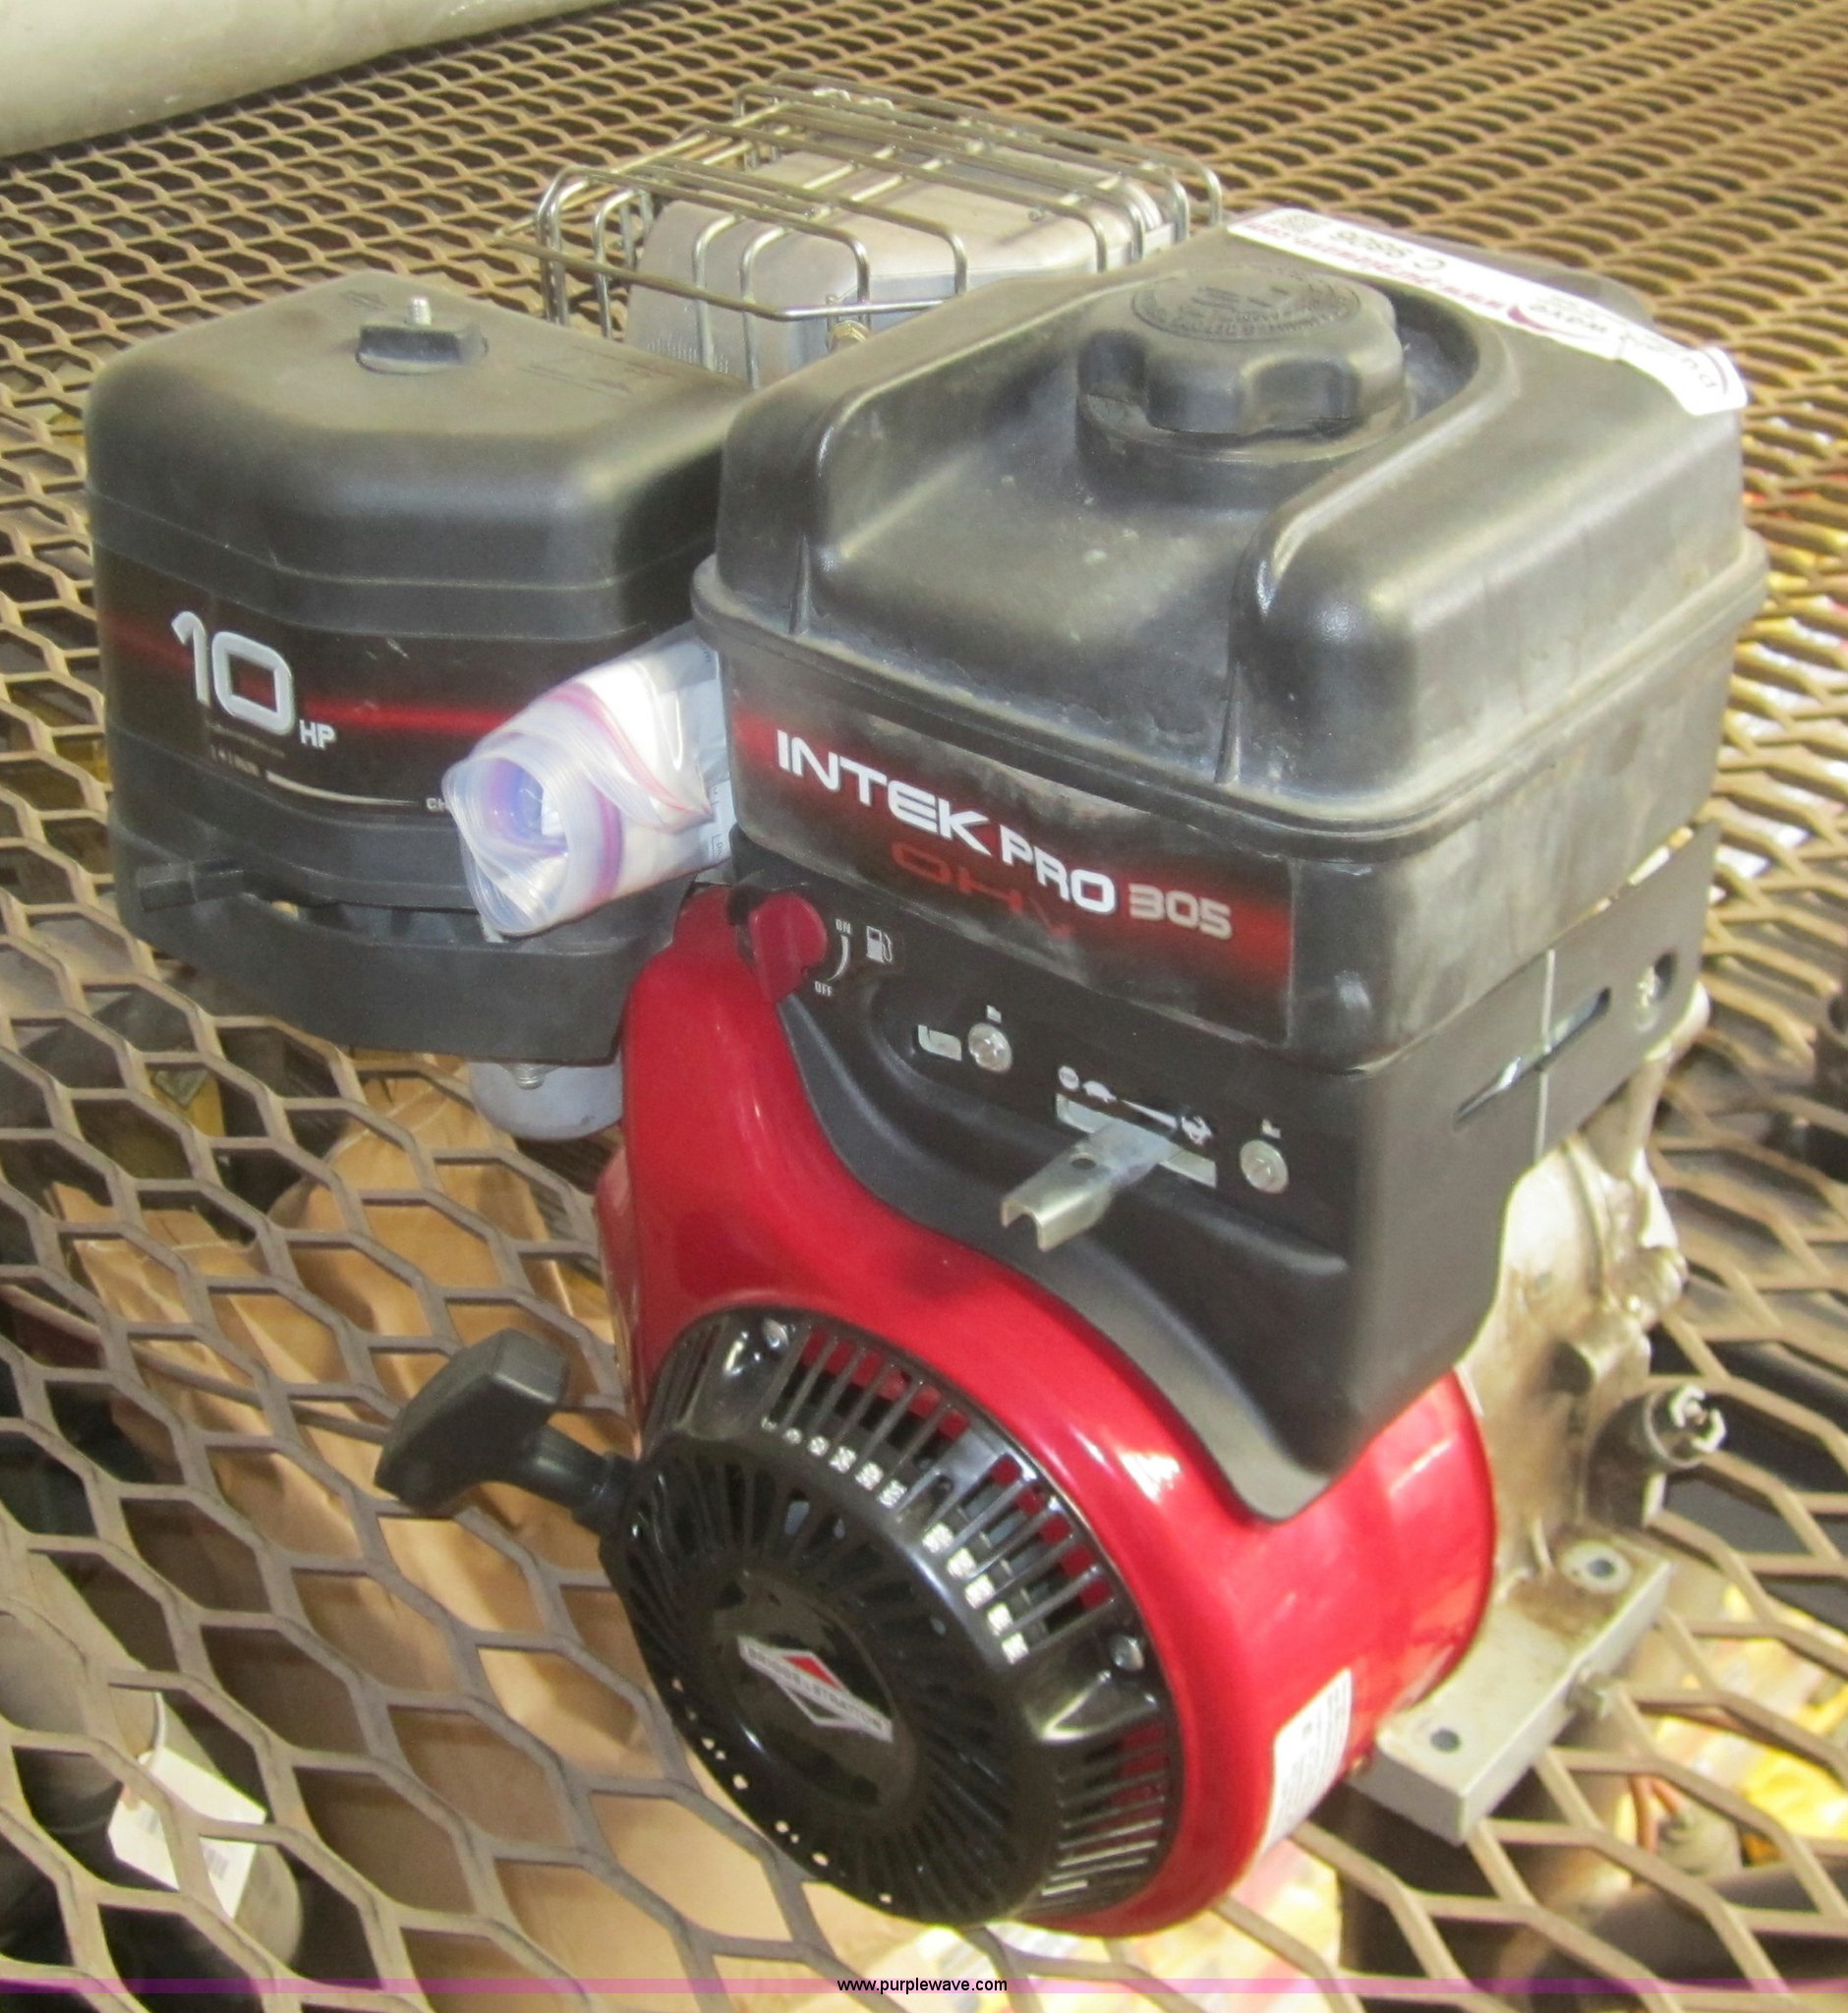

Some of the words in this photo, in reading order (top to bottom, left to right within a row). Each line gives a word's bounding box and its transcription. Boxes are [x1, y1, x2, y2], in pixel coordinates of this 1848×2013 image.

[171, 610, 294, 735] 10
[299, 719, 335, 750] HP
[777, 730, 991, 855] INTEK
[999, 824, 1118, 915] PRO
[1128, 883, 1234, 941] 305
[835, 918, 852, 935] ON
[814, 980, 834, 998] OFF
